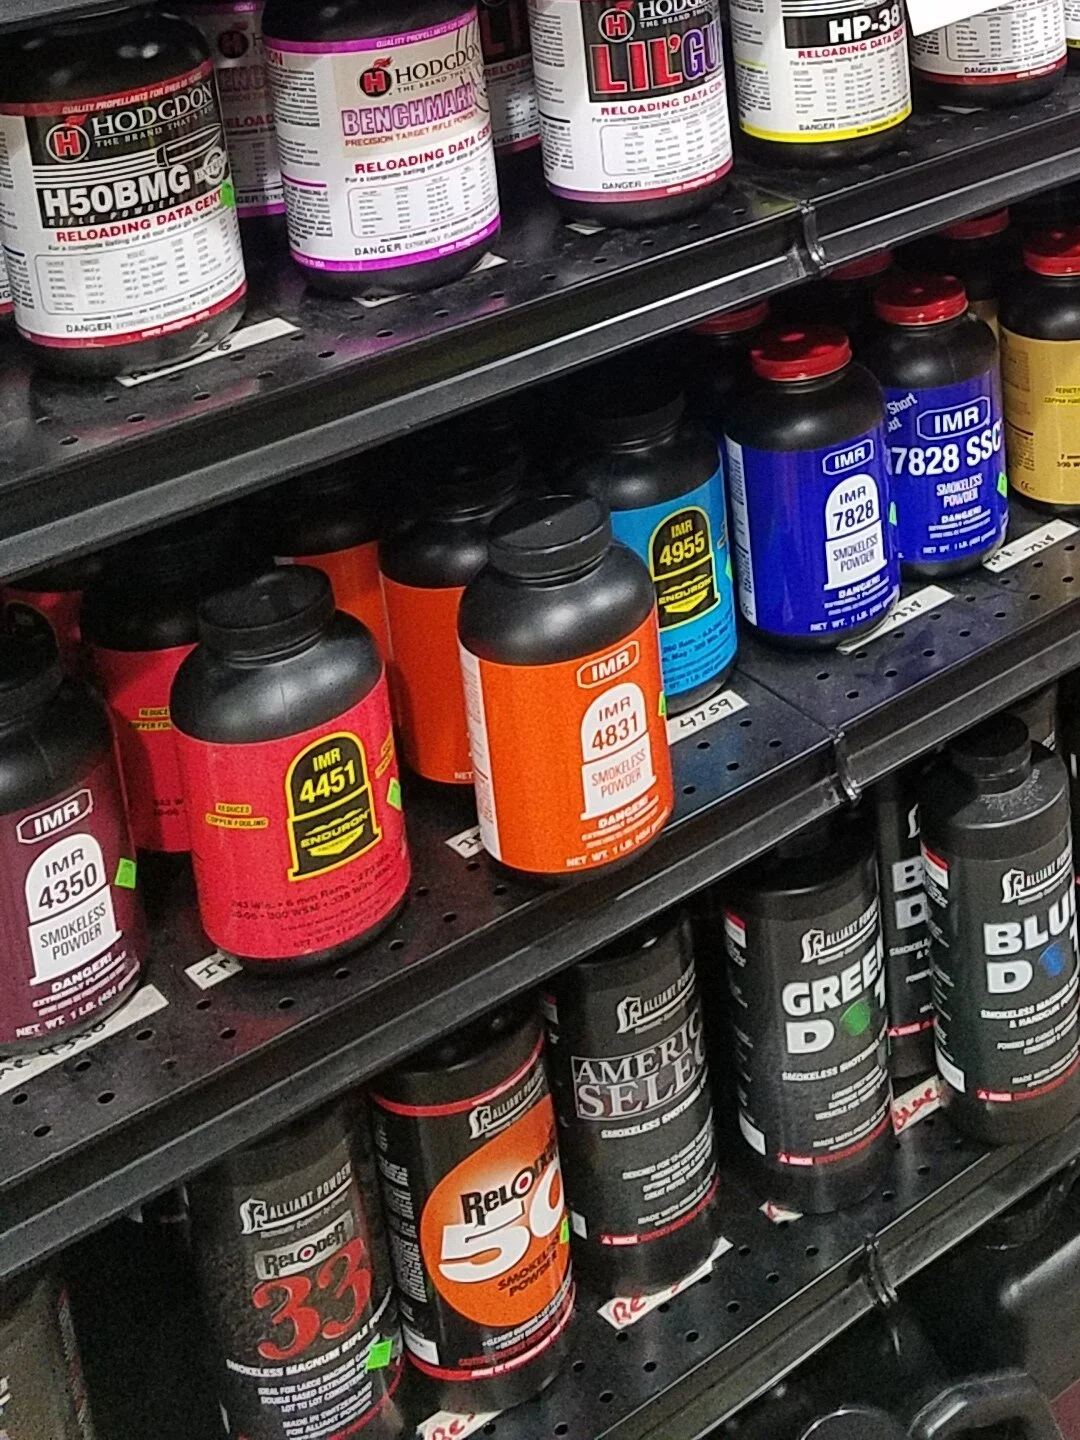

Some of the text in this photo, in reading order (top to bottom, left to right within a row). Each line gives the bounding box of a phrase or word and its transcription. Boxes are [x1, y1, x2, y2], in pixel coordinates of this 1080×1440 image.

[640, 13, 691, 28] THE BRAND
[376, 37, 405, 48] QUALITY
[798, 35, 892, 59] RELOADING DATA
[963, 64, 998, 75] DANGER
[397, 76, 448, 93] THE BRAND
[62, 88, 163, 115] QUALITY PROPELLANTS FOR
[92, 81, 213, 136] HODGDON
[601, 89, 709, 116] RELOADING DATA
[95, 127, 163, 148] THE BRAND
[344, 135, 395, 147] PRECISION
[397, 127, 430, 141] TARGET
[798, 122, 835, 132] DANGER
[355, 137, 477, 175] RELOADING DATA
[43, 163, 192, 219] H50BMG
[601, 181, 642, 190] DANGER
[48, 197, 176, 226] RIFLE POWDER
[56, 205, 193, 243] RELOADING DATA
[354, 242, 402, 257] DANGER
[65, 321, 112, 334] DANGER
[887, 392, 918, 416] Short
[934, 406, 980, 434] IMR
[834, 446, 866, 471] IMR
[891, 443, 960, 476] 7828
[839, 485, 866, 506] IMR
[671, 519, 693, 539] IMR
[832, 499, 875, 533] 7828
[660, 531, 705, 567] 4955
[832, 532, 879, 561] SMOKELESS
[840, 550, 875, 574] POWDER
[591, 651, 630, 682] IMR
[598, 696, 631, 722] IMR
[680, 698, 733, 729] 4759
[591, 711, 639, 751] 4831
[312, 747, 341, 773] IMR
[591, 748, 647, 788] SMOKELESS
[299, 760, 357, 804] 4451
[600, 768, 642, 799] POWDER
[33, 799, 81, 837] IMR
[217, 803, 251, 814] REDUCED
[233, 818, 267, 828] FOULING
[300, 810, 370, 850] ENDURON
[44, 847, 84, 879] IMR
[566, 856, 587, 868] NET
[38, 862, 98, 910] 4350
[40, 901, 107, 949] SMOKELESS
[825, 922, 856, 947] ALLIANT
[52, 923, 103, 961] POWDER
[642, 981, 676, 1018] ALLIANT
[16, 1024, 41, 1038] NET
[782, 1064, 838, 1082] SMOKELESS
[490, 1089, 524, 1121] ALLIANT
[601, 1117, 660, 1140] SMOKELESS
[269, 1189, 315, 1221] ALLIANT
[252, 1237, 373, 1361] 33
